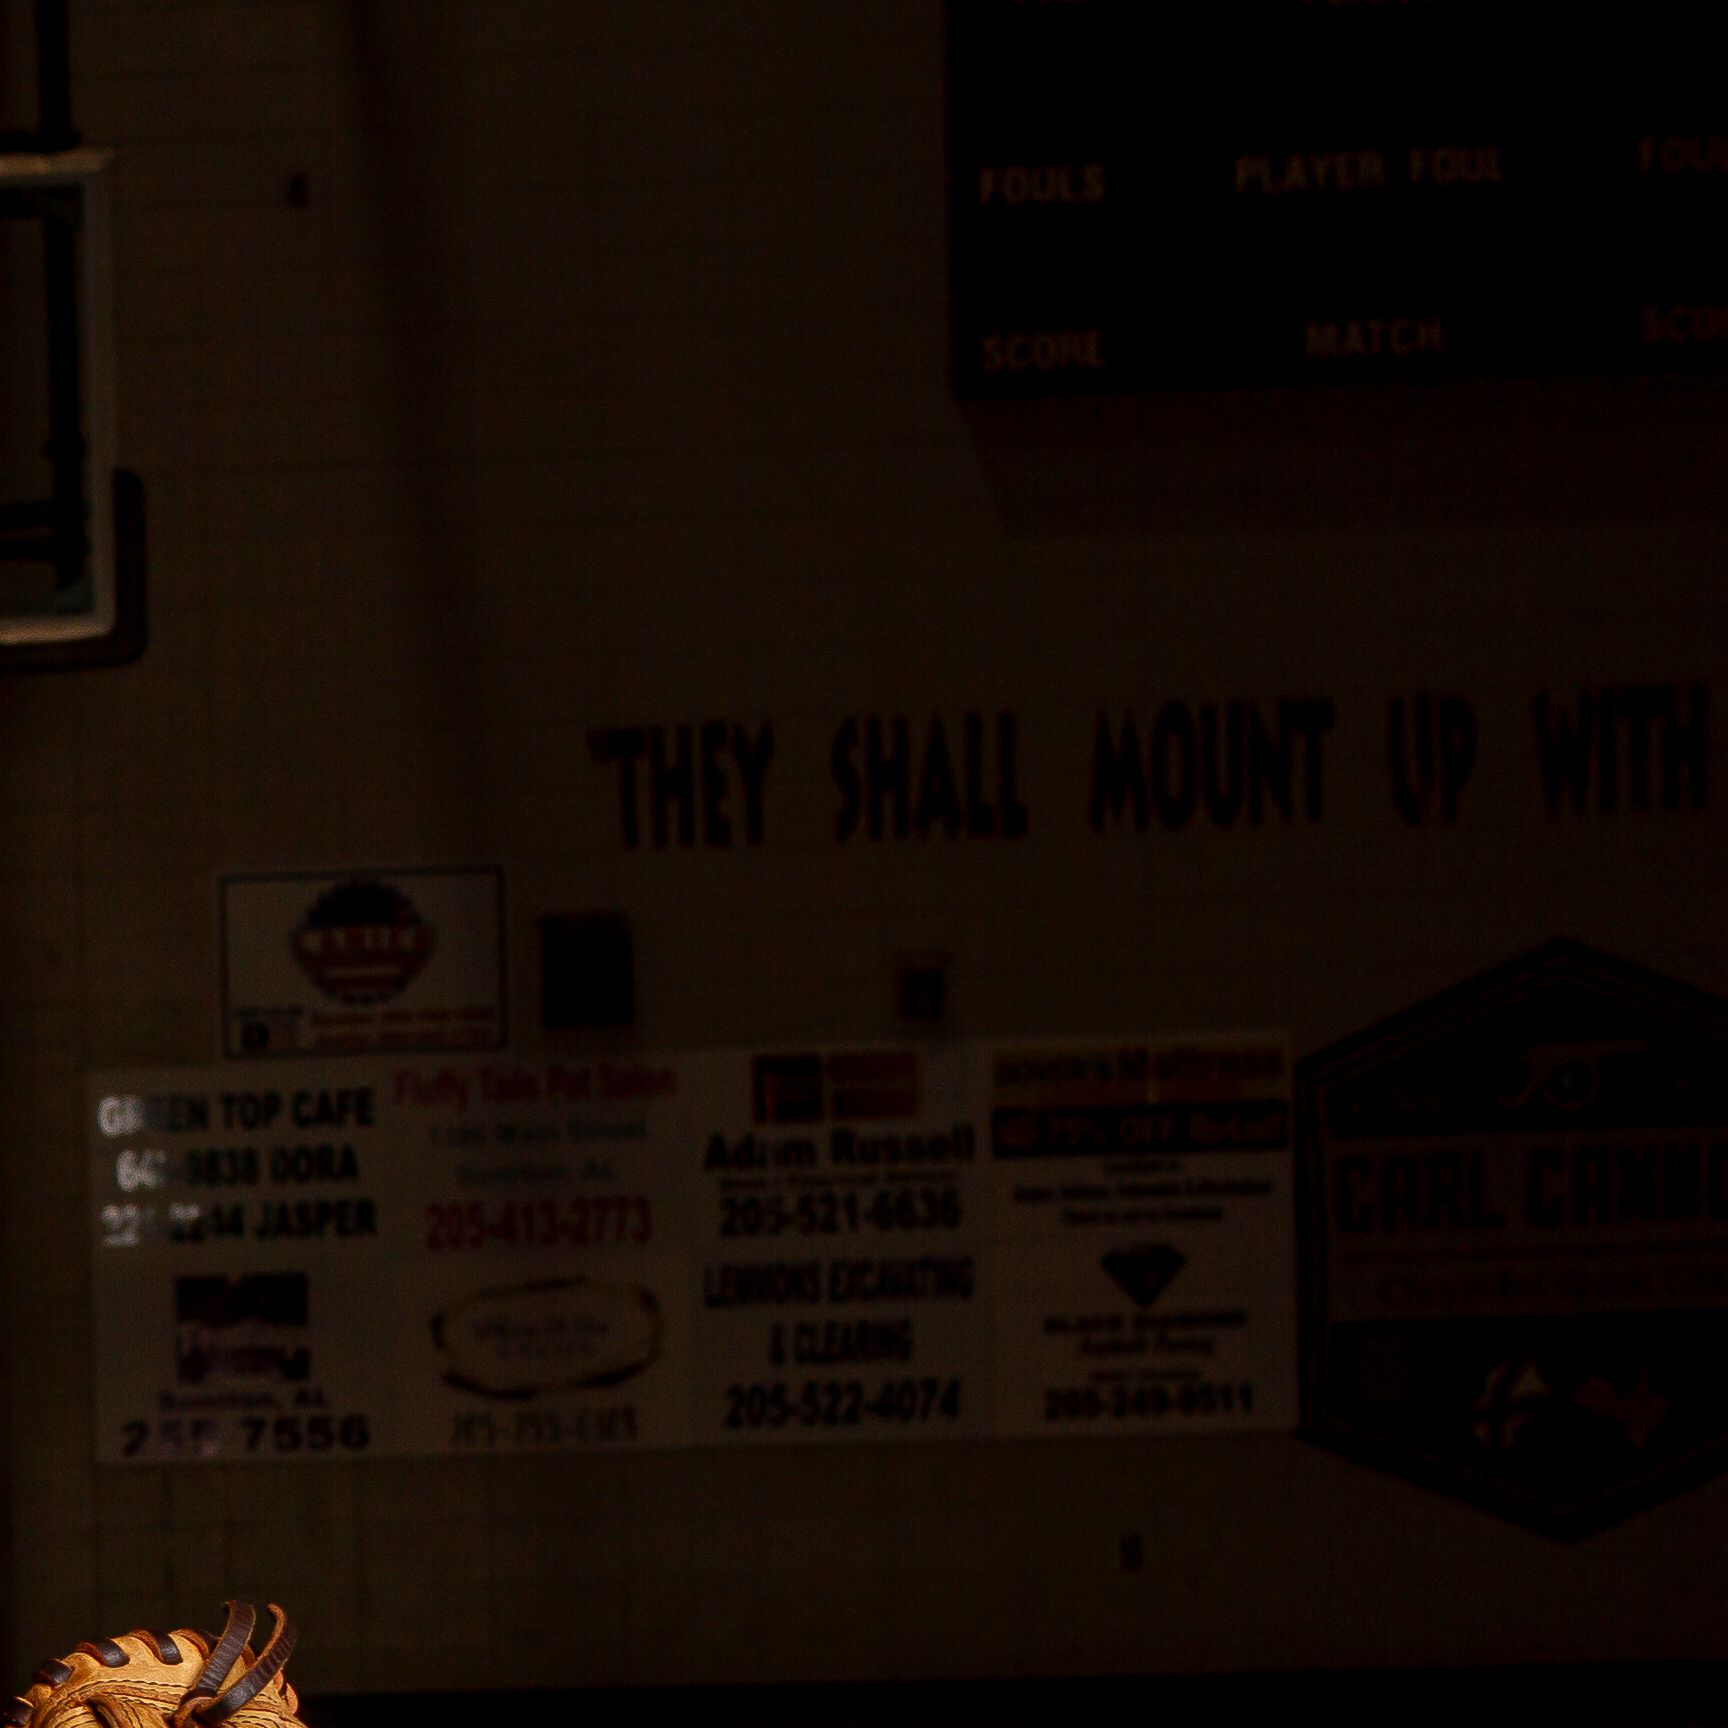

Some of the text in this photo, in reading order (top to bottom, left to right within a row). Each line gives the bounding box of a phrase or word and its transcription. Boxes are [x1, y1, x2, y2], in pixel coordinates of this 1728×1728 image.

[977, 162, 1107, 207] FOULS
[1233, 144, 1506, 194] PLAYER FOUL
[980, 328, 1106, 374] SCORE
[1304, 314, 1444, 361] MATCH
[831, 711, 1028, 843] SHALL
[1088, 697, 1336, 834] MOUNT
[1388, 694, 1477, 828] UP
[1532, 680, 1710, 818] WITH
[220, 1092, 279, 1129] TOP
[292, 1087, 374, 1127] CAFE
[272, 1146, 359, 1185] DORA
[704, 1131, 817, 1168] Adam
[831, 1123, 975, 1163] Russell
[1338, 1150, 1508, 1232] CARL
[255, 1199, 378, 1239] JASPER
